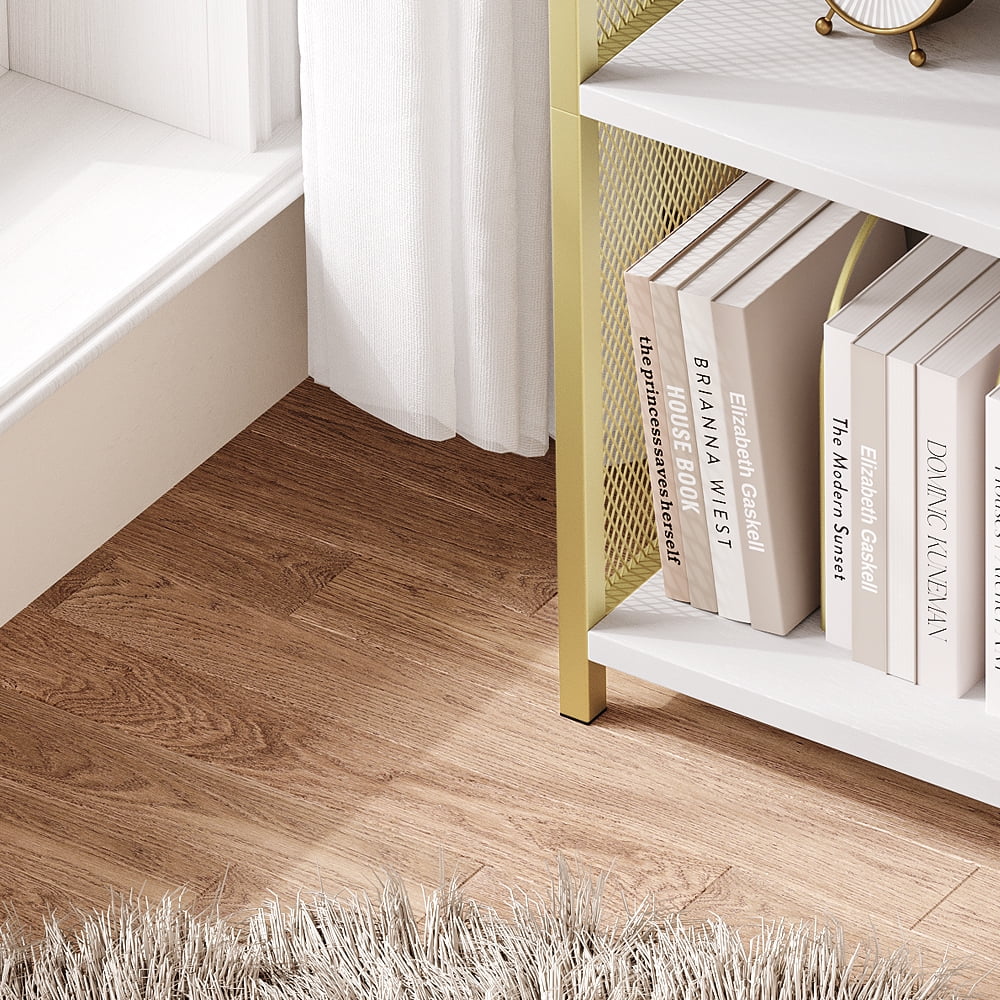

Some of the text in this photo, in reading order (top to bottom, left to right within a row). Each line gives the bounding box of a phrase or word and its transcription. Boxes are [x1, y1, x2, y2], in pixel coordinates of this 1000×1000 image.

[666, 384, 700, 514] HOUSE BOOK
[694, 356, 732, 548] BRIANNA WIEST
[729, 392, 765, 552] Elizabeth Gaskell
[832, 417, 850, 581] The Modern Sunset
[860, 444, 878, 594] Elizabeth Gaskell
[926, 438, 948, 643] DOMINIC KUNEMAN
